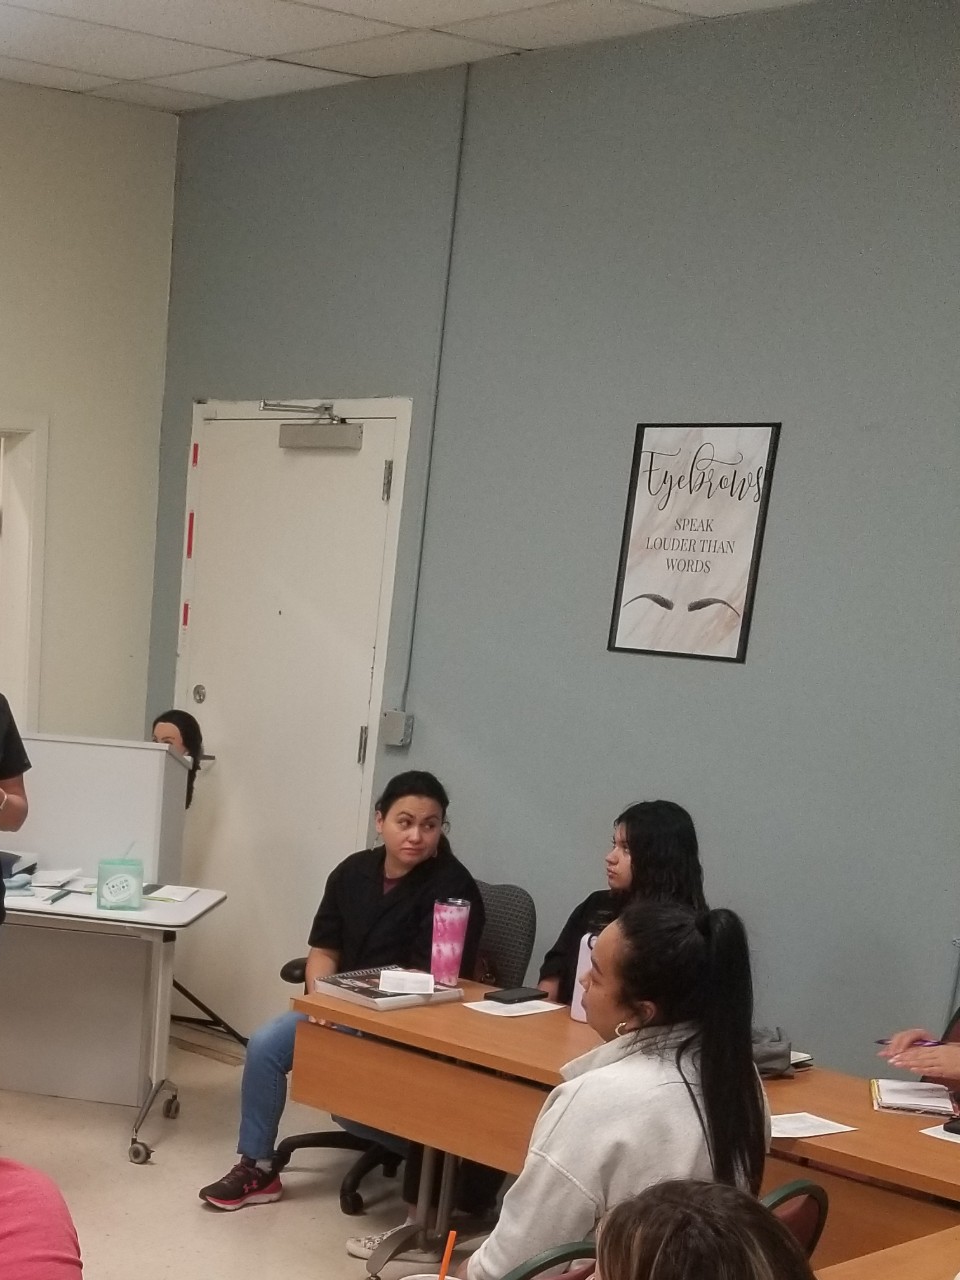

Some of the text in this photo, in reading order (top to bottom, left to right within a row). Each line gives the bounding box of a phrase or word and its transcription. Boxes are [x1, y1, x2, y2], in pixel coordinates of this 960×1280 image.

[642, 442, 764, 511] Eyebrows
[674, 518, 714, 532] SPEAK
[646, 536, 736, 554] LOUDER THAN
[666, 557, 711, 574] WORDS
